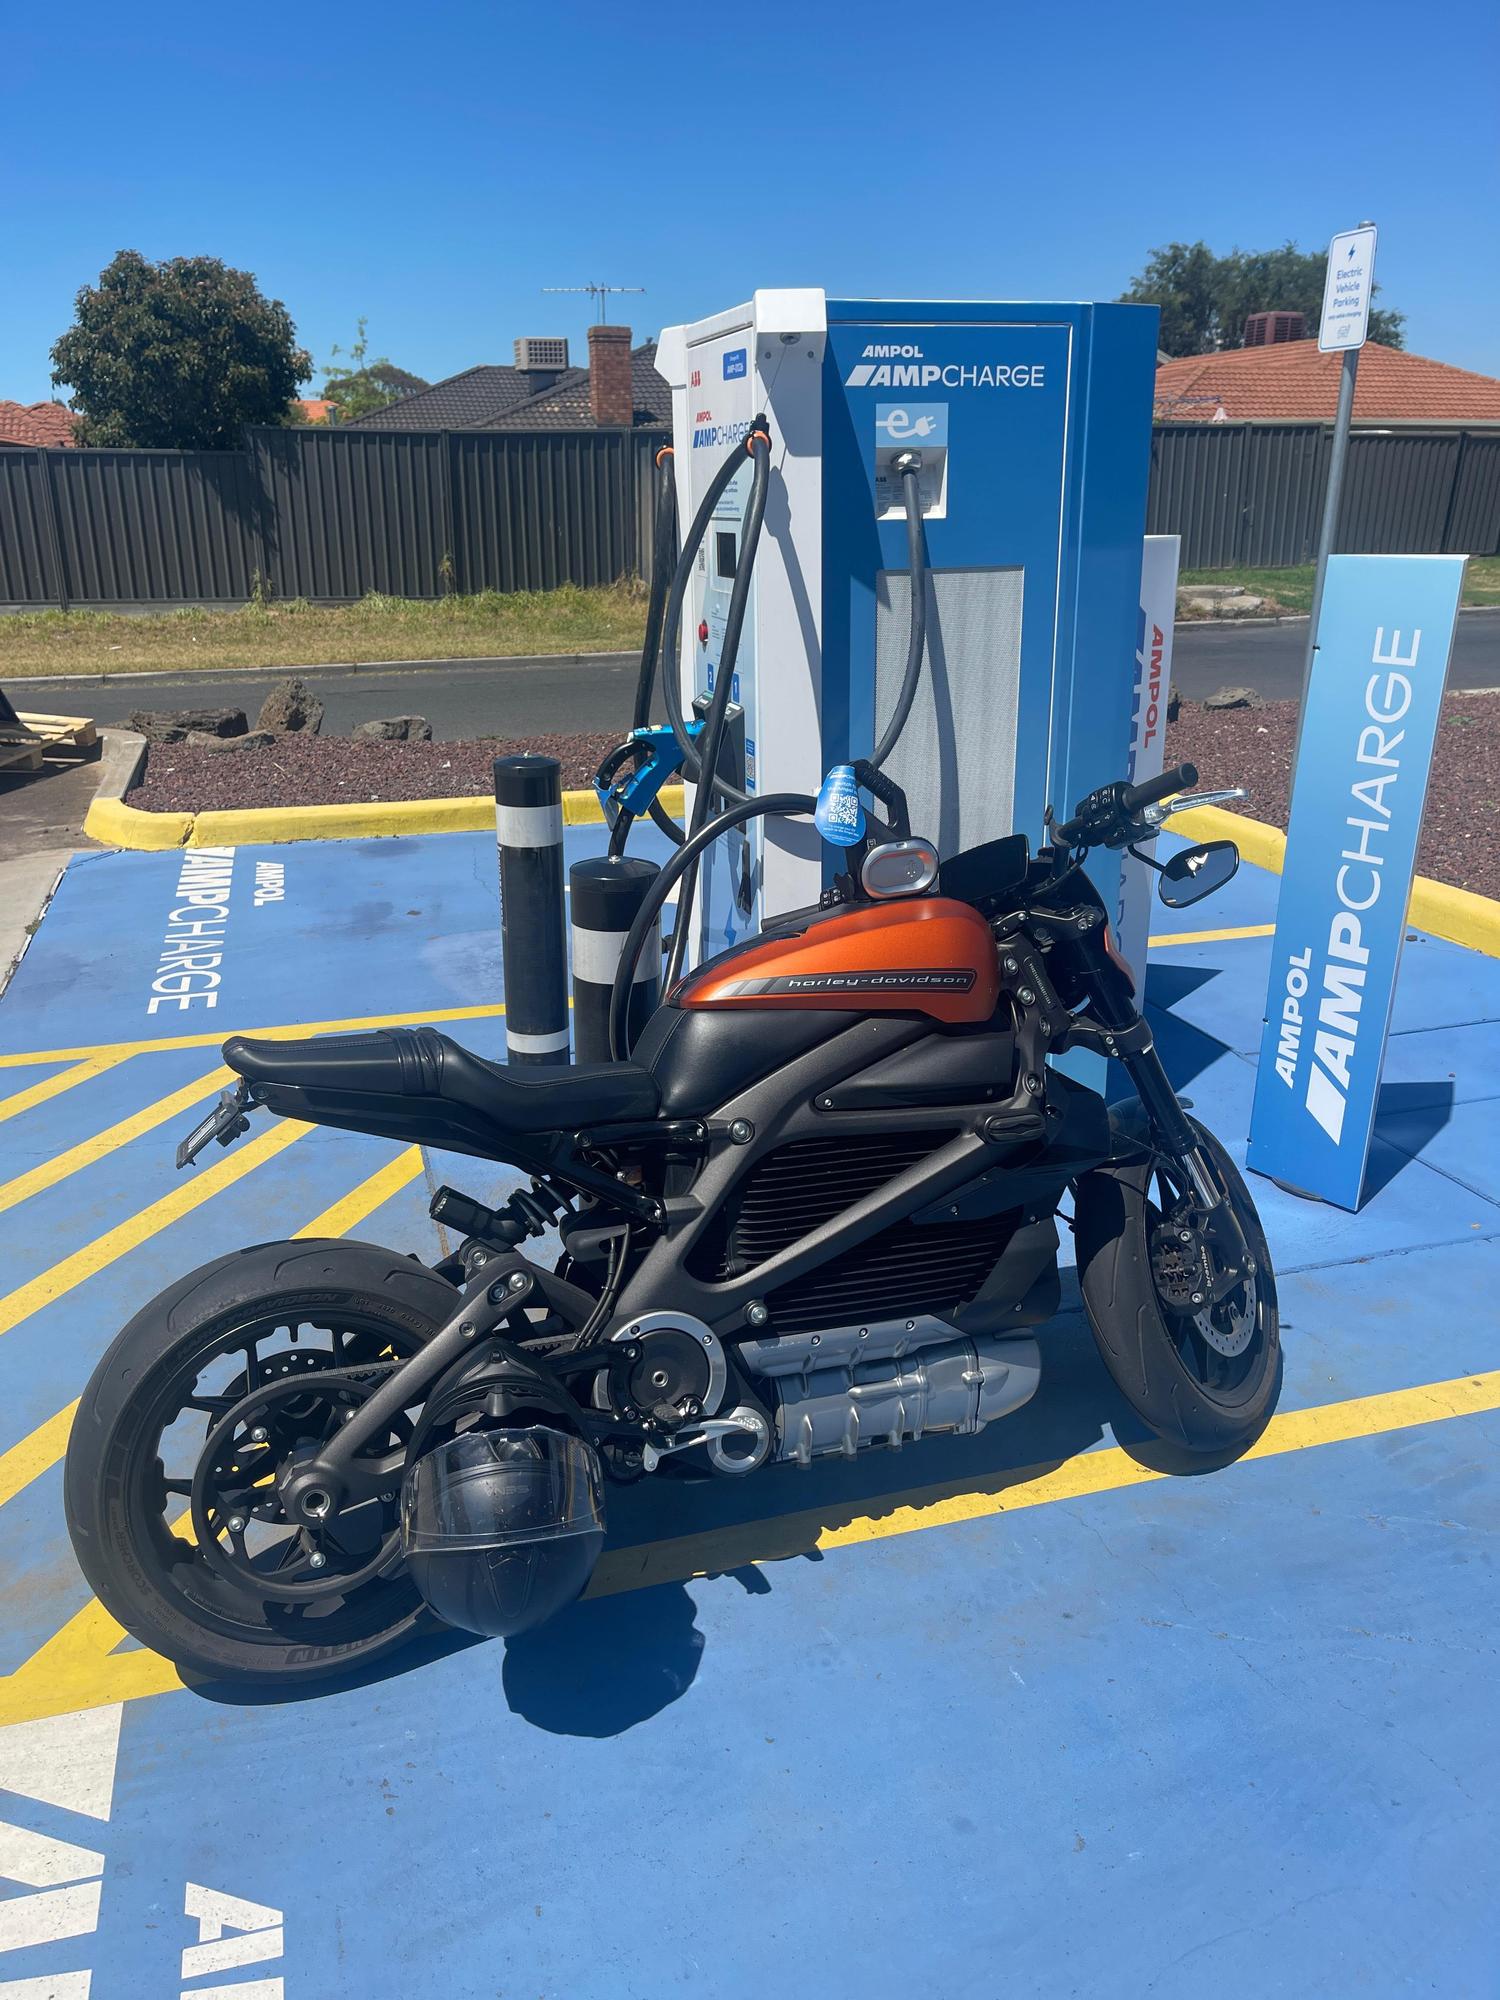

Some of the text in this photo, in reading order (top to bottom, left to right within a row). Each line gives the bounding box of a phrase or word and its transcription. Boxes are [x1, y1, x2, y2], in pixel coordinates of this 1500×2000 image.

[1337, 267, 1363, 280] Electric
[1336, 282, 1360, 293] Vehicle
[1333, 296, 1360, 308] Parking
[862, 345, 924, 358] AMPOL
[690, 369, 702, 389] ABB
[868, 364, 1045, 387] AMPCHARGE
[695, 411, 712, 423] AMPOL
[1143, 624, 1162, 749] AMPOL
[1313, 626, 1422, 1091] AMPCHARGE
[253, 861, 286, 907] AMPOL
[146, 853, 235, 1015] AMPCHARGE
[788, 975, 968, 987] harley-davidson
[1274, 946, 1312, 1090] AMPOL
[1201, 1246, 1212, 1287] brembo
[114, 1530, 152, 1597] SCORCHER
